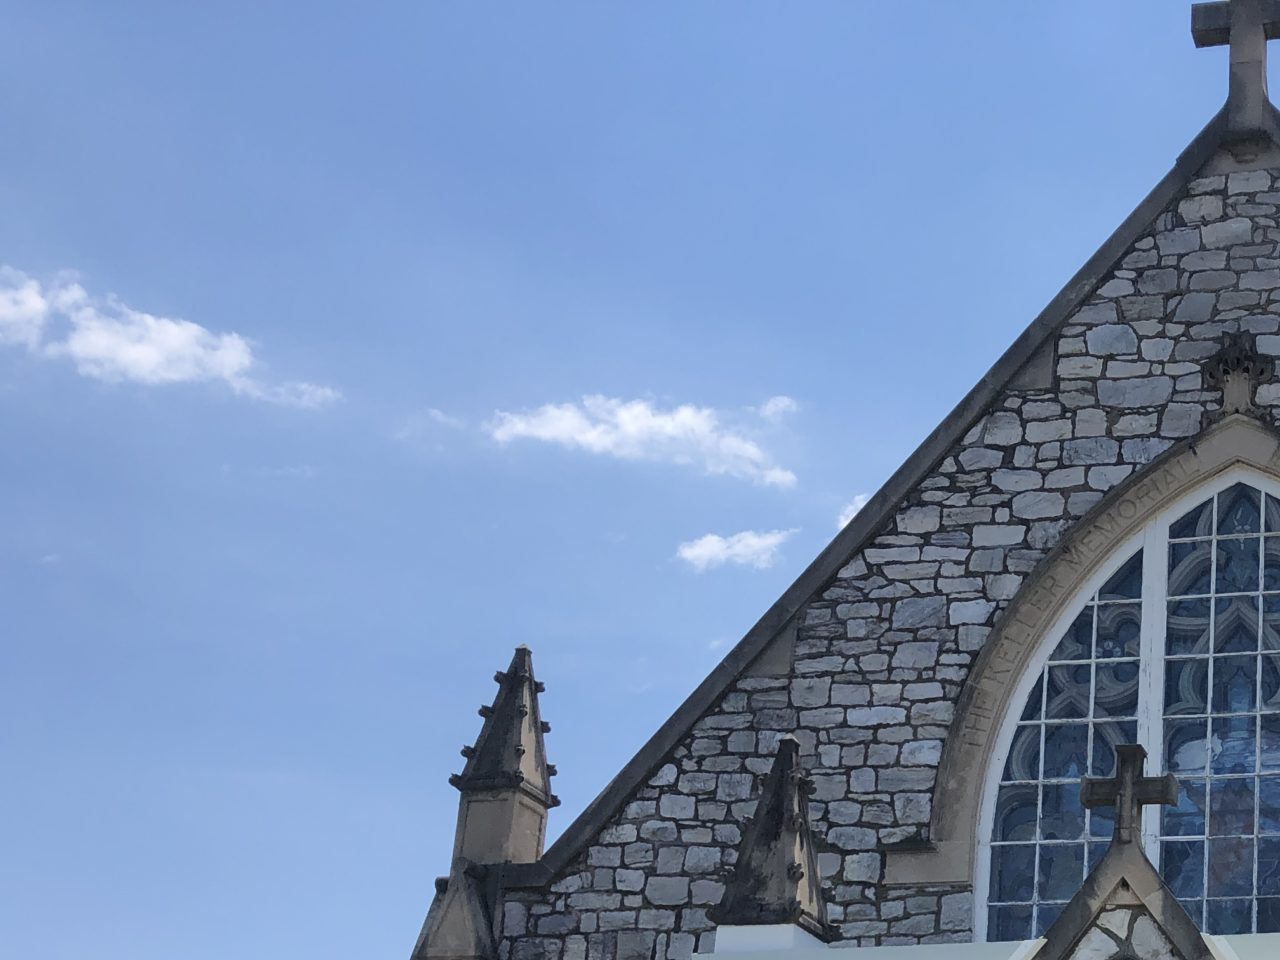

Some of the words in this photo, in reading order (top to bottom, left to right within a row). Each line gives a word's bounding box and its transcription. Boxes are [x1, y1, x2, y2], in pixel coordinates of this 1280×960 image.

[958, 691, 992, 751] THE
[981, 575, 1064, 684] KELLER
[1060, 459, 1200, 572] MEMORIAL
